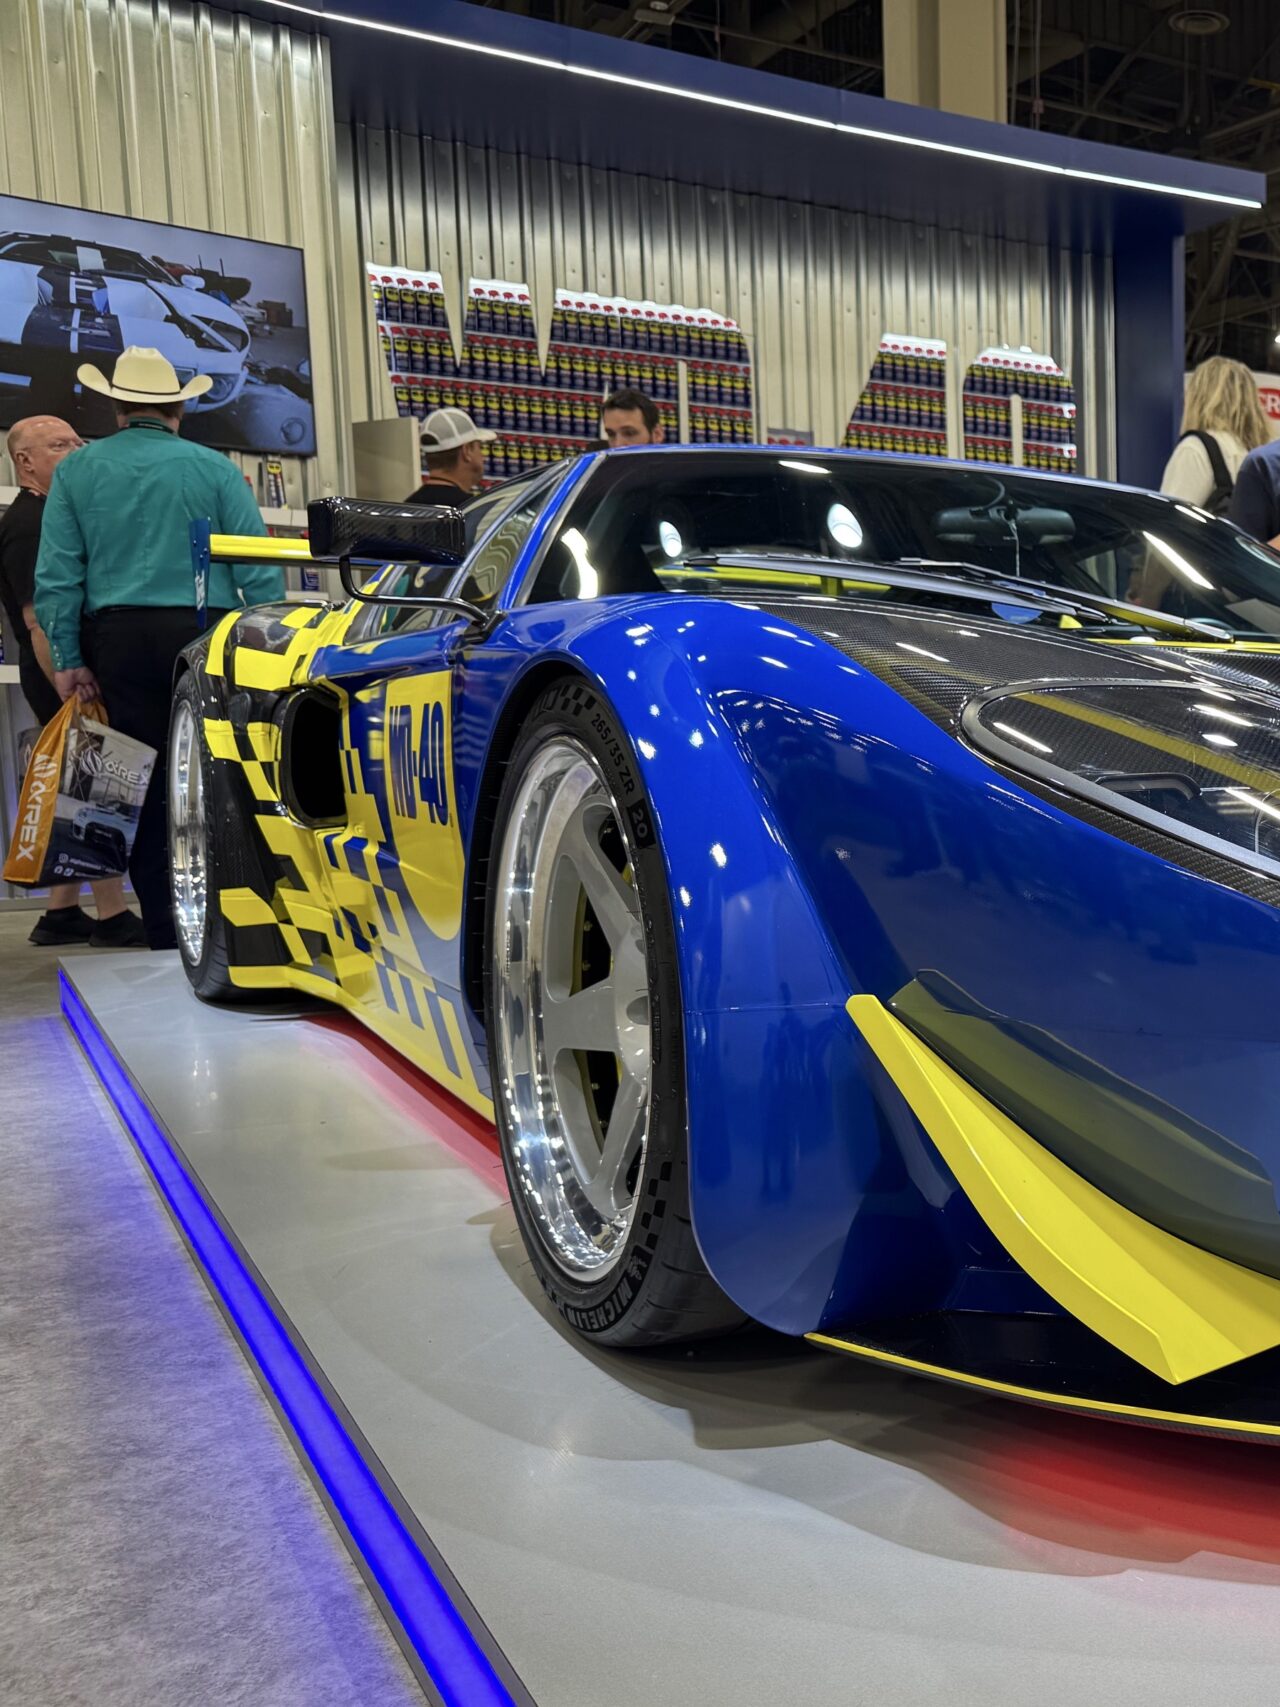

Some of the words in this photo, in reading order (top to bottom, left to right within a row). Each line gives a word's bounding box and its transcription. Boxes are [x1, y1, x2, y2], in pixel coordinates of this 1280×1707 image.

[389, 701, 449, 826] WD-40
[591, 713, 625, 767] 265/35
[619, 766, 636, 795] ZR
[631, 808, 648, 838] 20
[566, 1277, 635, 1330] MICHELIN
